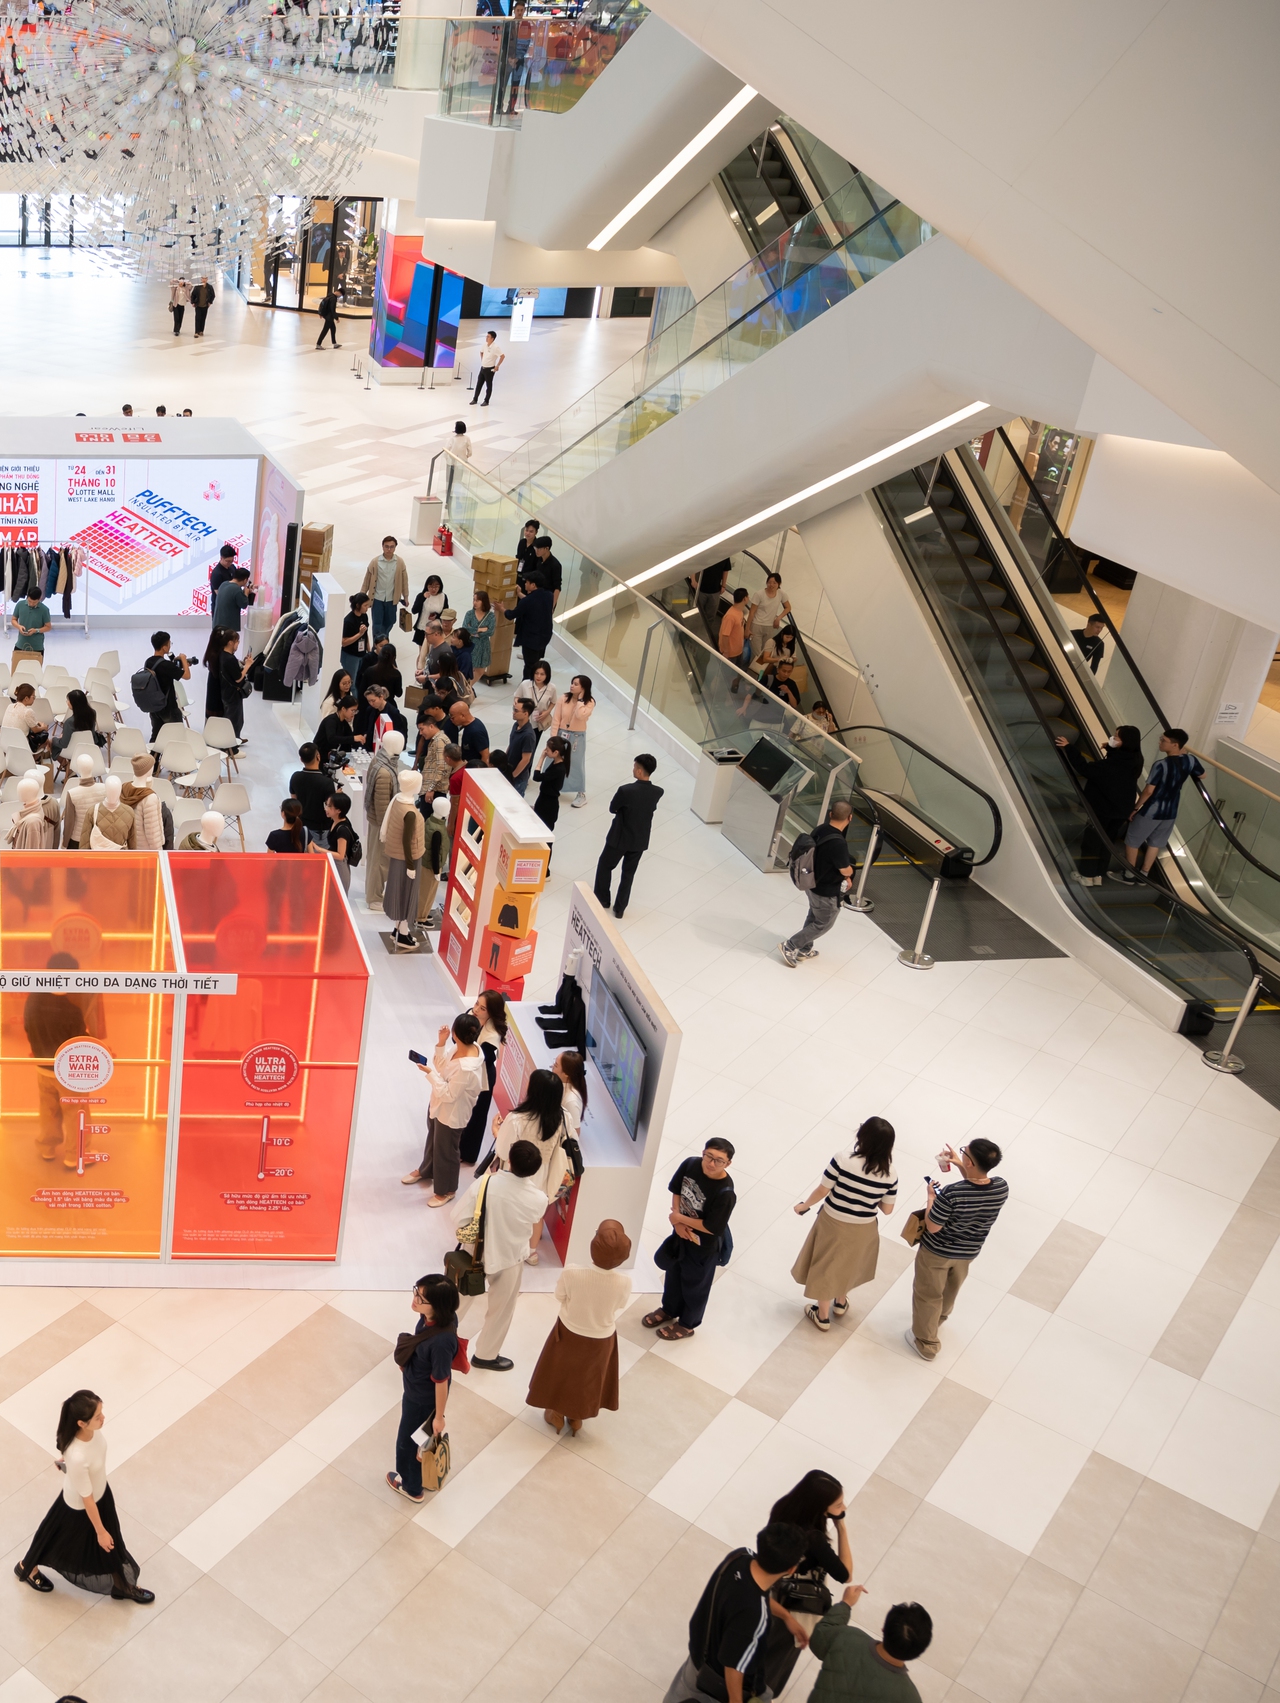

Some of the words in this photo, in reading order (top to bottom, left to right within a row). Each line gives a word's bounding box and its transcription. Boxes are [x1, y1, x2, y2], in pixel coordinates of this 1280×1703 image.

[24, 465, 40, 473] THIỆU
[75, 466, 86, 475] 24
[106, 466, 116, 475] 31
[15, 480, 39, 493] NGHỆ
[68, 476, 101, 487] THÁNG
[106, 479, 116, 487] 10
[135, 489, 218, 537] PUFFTECH
[1, 516, 16, 524] TÍNH
[18, 516, 38, 525] NĂNG
[128, 497, 172, 525] INSULATED
[173, 524, 186, 533] BY
[185, 531, 201, 542] AIR
[106, 510, 183, 557] HEATTECH
[88, 555, 132, 584] TECHNOLOGY
[571, 910, 602, 970] HEATTECH
[11, 975, 31, 987] GIỮ
[35, 975, 71, 990] NHIỆT
[75, 977, 99, 987] CHO
[104, 977, 120, 988] ĐA
[125, 978, 157, 990] DẠNG
[162, 977, 188, 989] THỜI
[193, 977, 220, 990] TIẾT
[69, 1055, 99, 1063] EXTRA
[255, 1057, 286, 1065] ULTRA
[69, 1063, 99, 1071] WARM
[255, 1065, 286, 1073] WARM
[90, 1126, 108, 1134] 15°C
